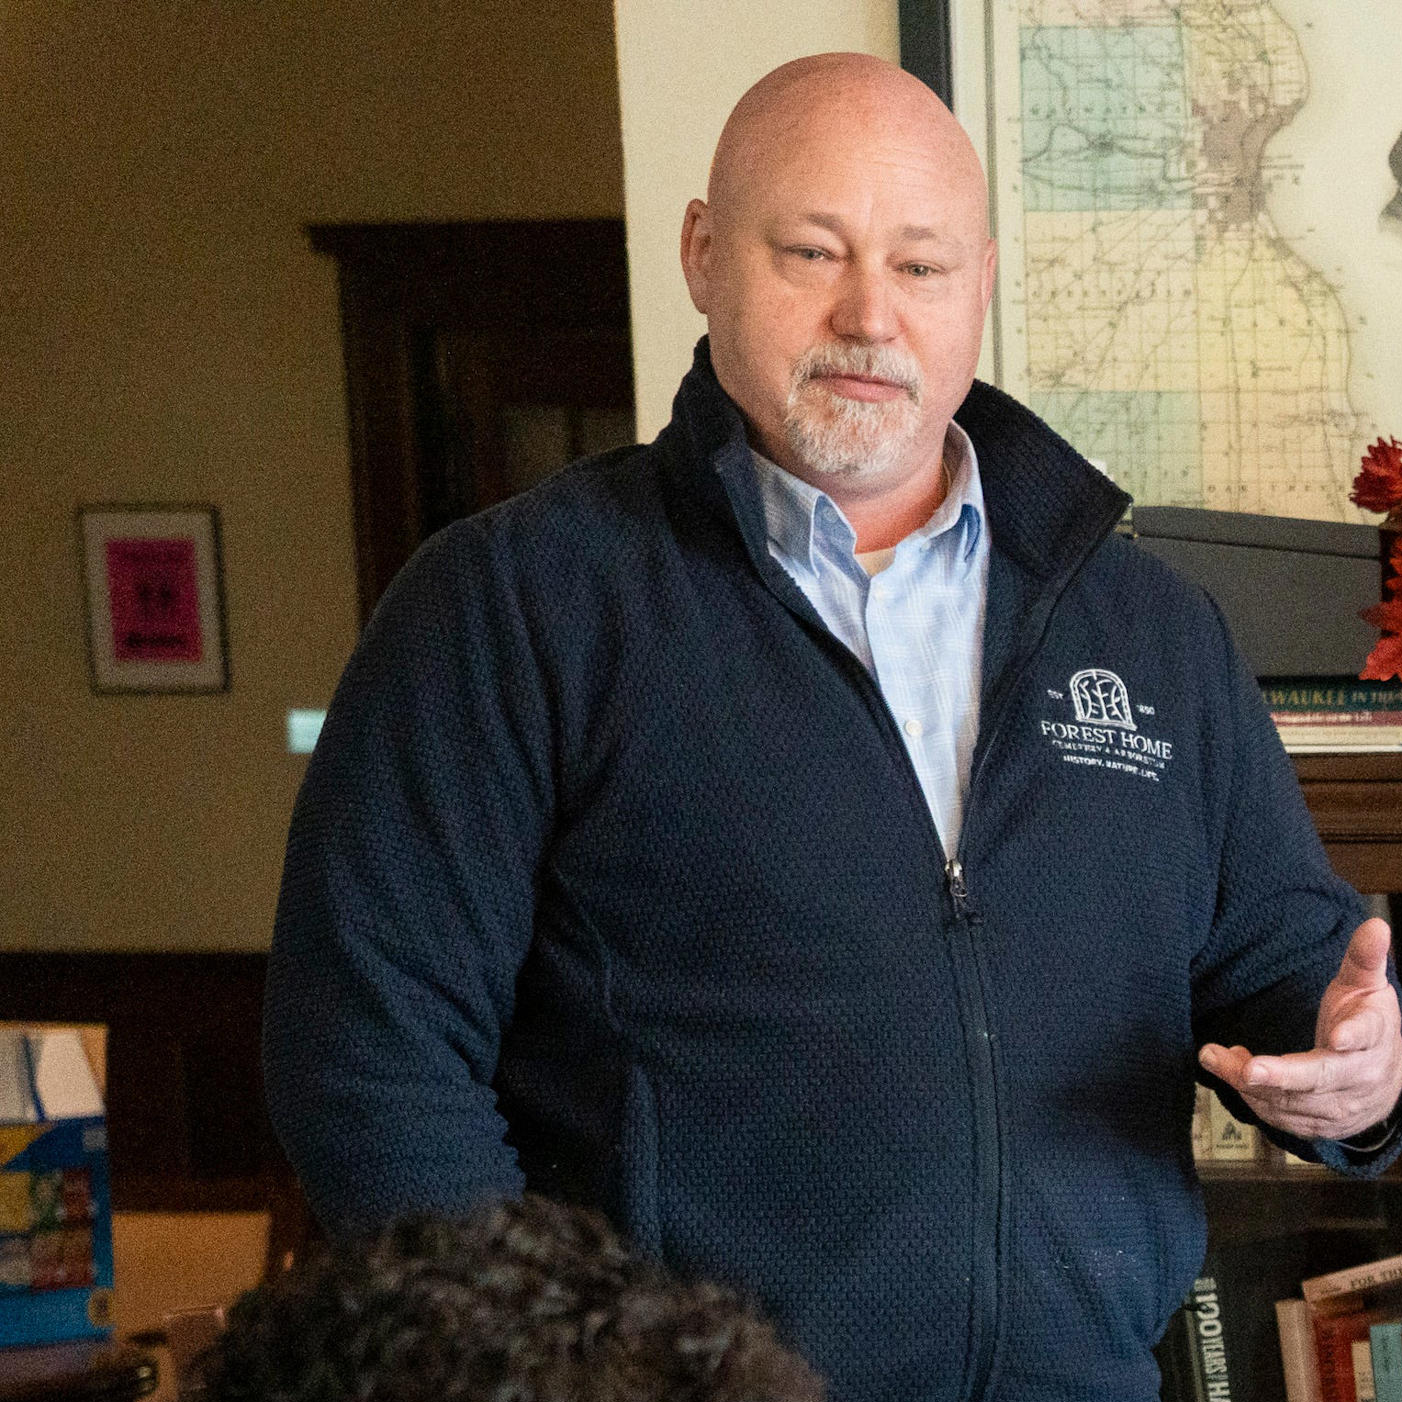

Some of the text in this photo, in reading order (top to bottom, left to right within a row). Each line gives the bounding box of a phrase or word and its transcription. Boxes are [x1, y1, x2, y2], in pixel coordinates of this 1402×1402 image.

[1041, 720, 1173, 760] FOREST HOME
[1349, 1274, 1376, 1290] FOR
[1195, 1291, 1222, 1338] 100
